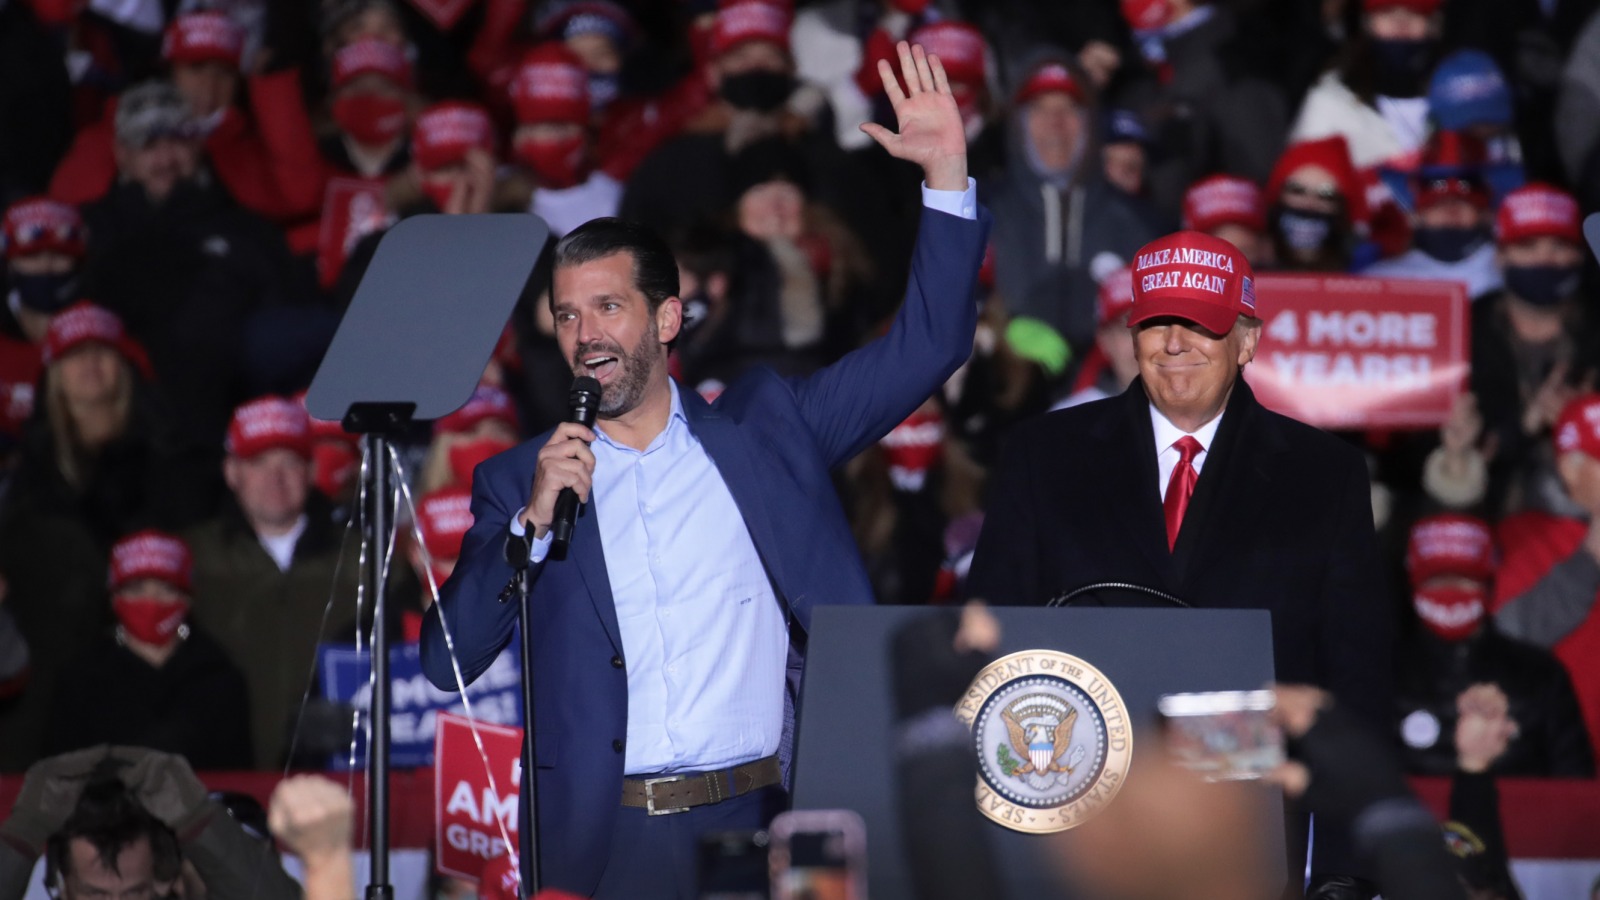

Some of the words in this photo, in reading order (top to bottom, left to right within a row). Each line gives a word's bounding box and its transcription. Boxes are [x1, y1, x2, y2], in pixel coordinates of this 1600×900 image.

[1136, 249, 1171, 271] MAKE
[1171, 248, 1234, 273] AMERICA
[1141, 271, 1181, 293] GREAT
[1182, 271, 1227, 294] AGAIN
[1268, 310, 1298, 344] 4
[1307, 310, 1437, 347] MORE
[1271, 352, 1432, 389] YEARS!
[957, 656, 1034, 724] RESIDENT
[1039, 658, 1057, 671] OF
[1060, 662, 1084, 681] THE
[1087, 678, 1128, 752] UNITED
[976, 786, 1026, 824] SEAL
